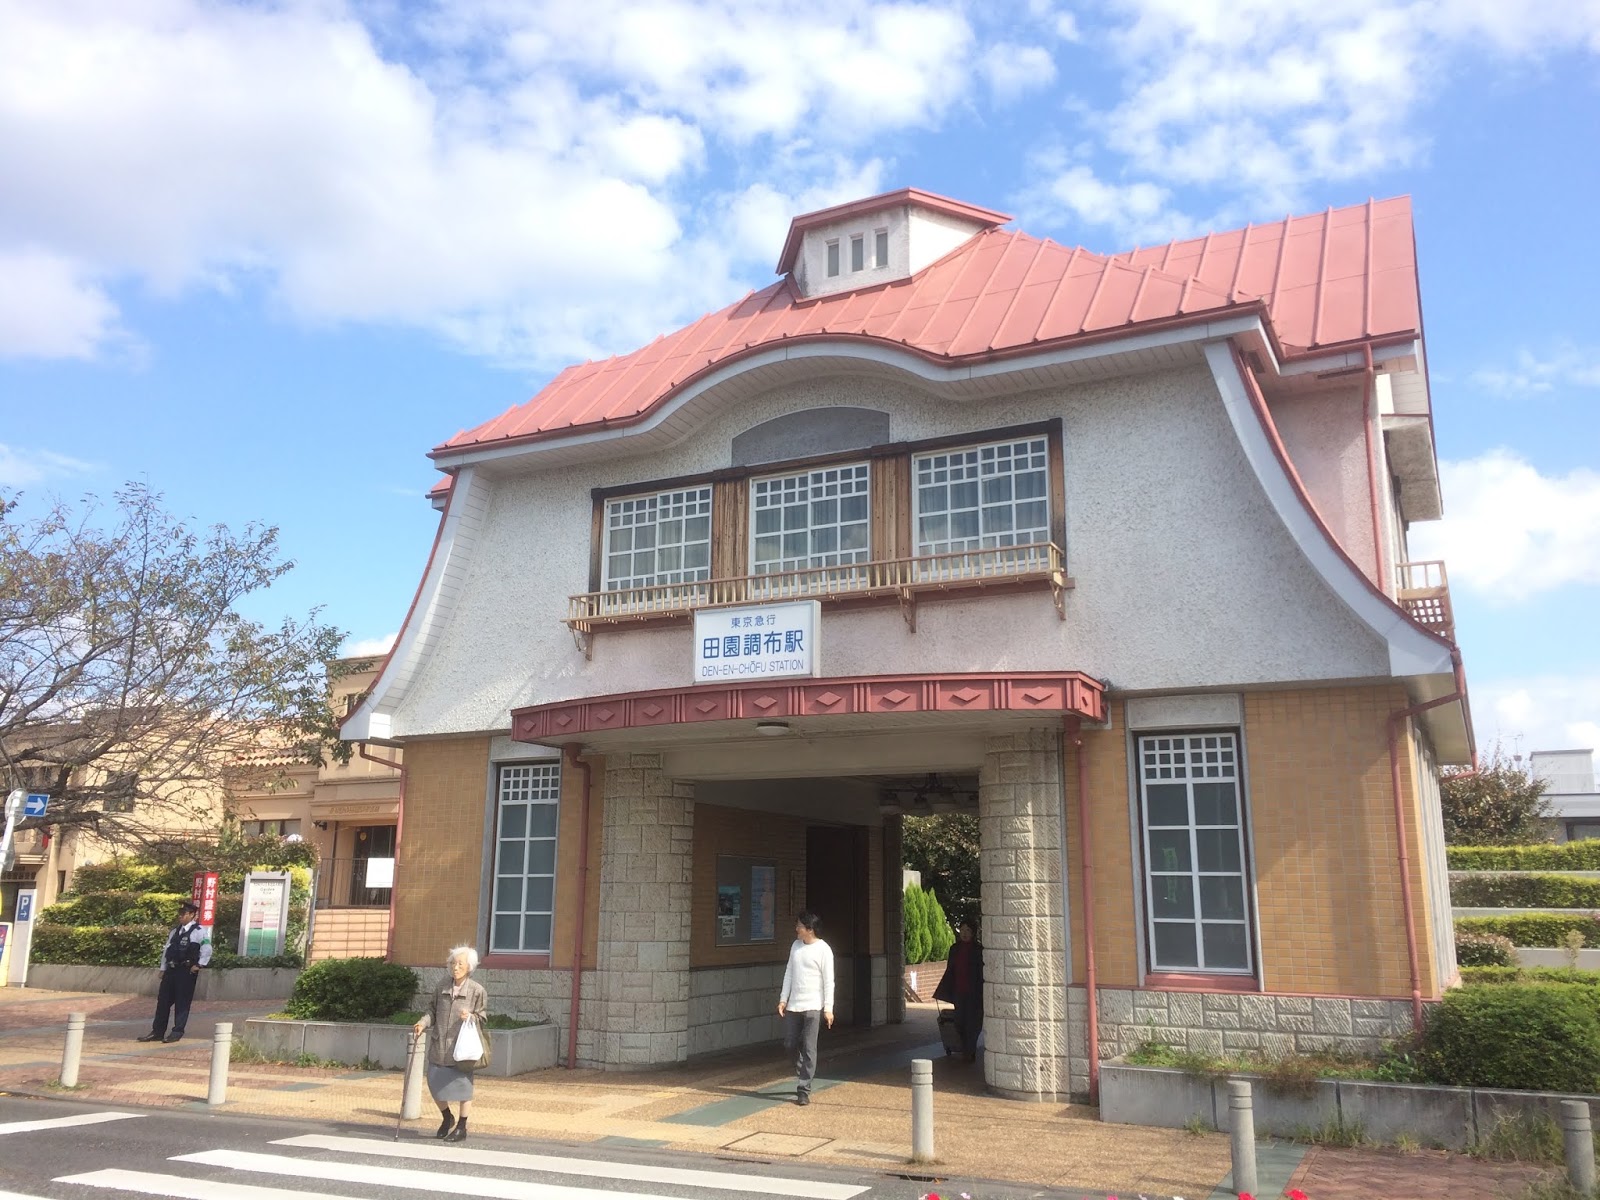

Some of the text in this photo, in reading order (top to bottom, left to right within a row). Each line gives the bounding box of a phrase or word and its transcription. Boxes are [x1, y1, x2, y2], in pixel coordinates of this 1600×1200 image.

[731, 614, 776, 628] 東京急行
[703, 629, 804, 659] 田園調布駅
[769, 659, 804, 672] STATION
[21, 897, 29, 910] P
